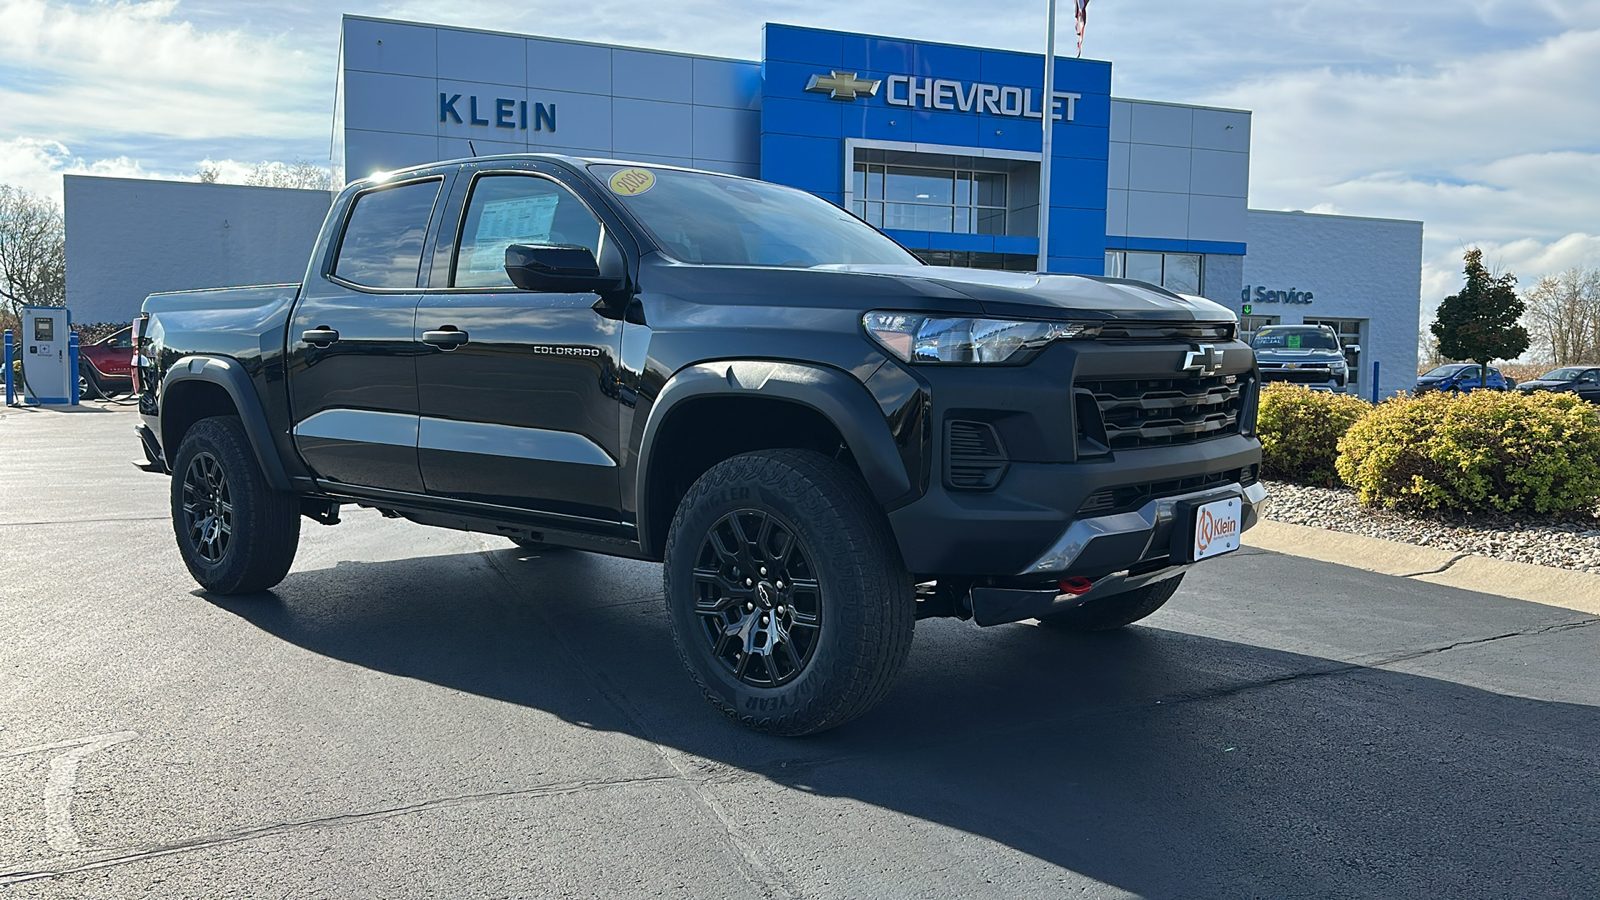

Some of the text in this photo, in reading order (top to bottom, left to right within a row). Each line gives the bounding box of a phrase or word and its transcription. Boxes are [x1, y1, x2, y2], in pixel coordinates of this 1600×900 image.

[886, 74, 1081, 121] CHEVROLET
[440, 92, 556, 133] KLEIN
[616, 169, 649, 193] 2026
[1254, 286, 1314, 305] Service
[533, 346, 600, 357] COLORADO
[1214, 516, 1236, 536] Klein
